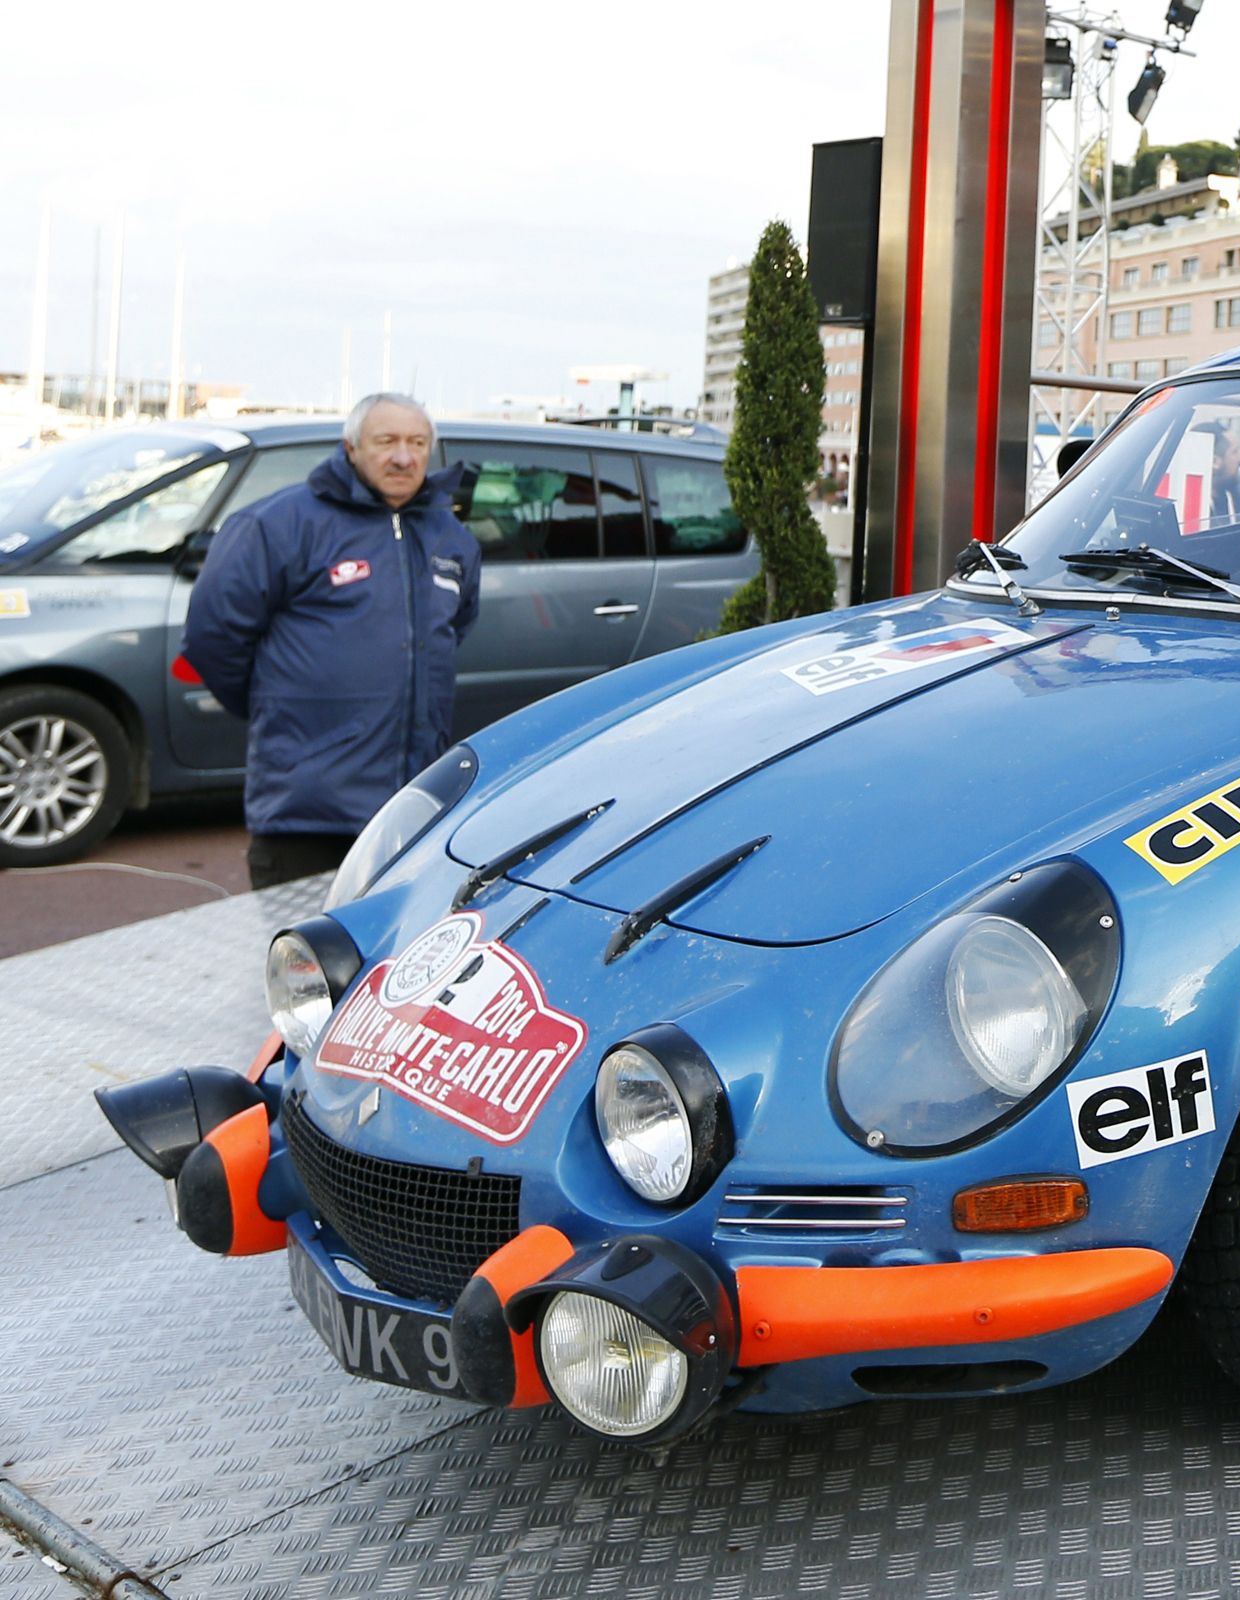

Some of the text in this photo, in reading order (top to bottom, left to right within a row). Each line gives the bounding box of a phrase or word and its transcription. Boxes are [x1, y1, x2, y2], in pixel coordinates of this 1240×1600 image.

[330, 982, 394, 1049] RALLYE
[474, 980, 536, 1044] 2014
[1078, 1057, 1207, 1154] elf
